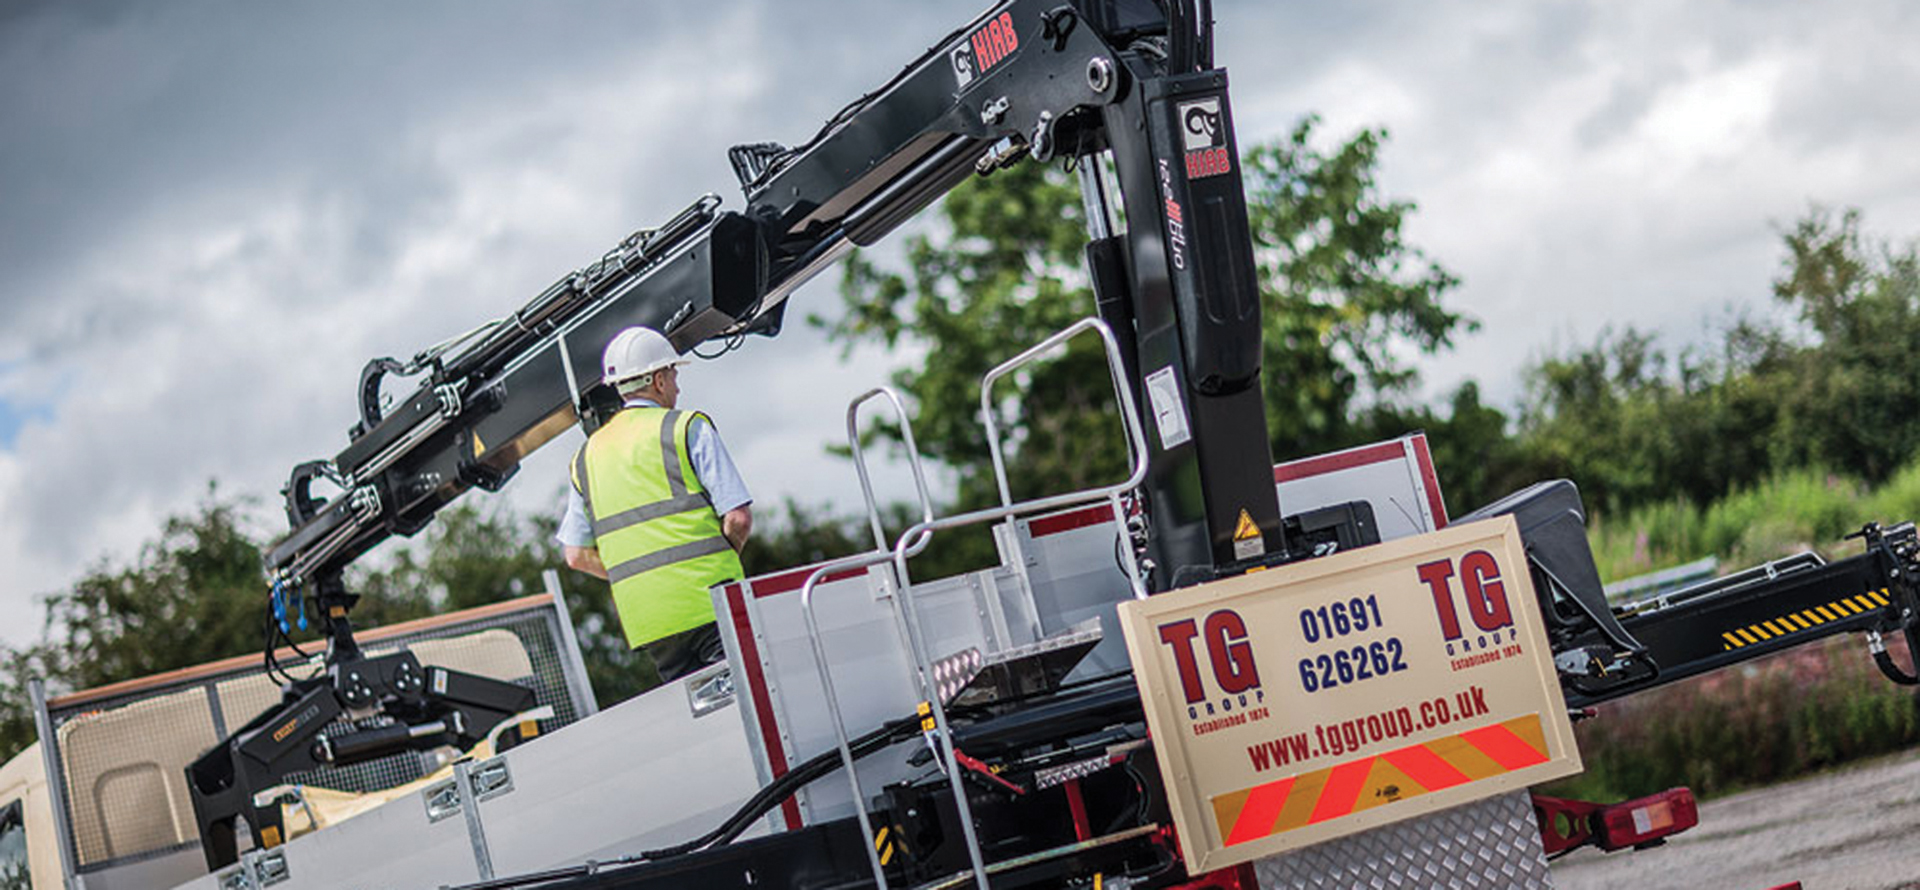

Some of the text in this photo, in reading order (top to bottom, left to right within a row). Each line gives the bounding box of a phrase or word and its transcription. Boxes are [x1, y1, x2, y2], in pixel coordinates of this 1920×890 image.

[971, 12, 1019, 73] HIAB
[1185, 148, 1230, 179] HIAB
[1299, 594, 1383, 644] 01691
[1416, 549, 1515, 642] TG
[1157, 608, 1262, 705] TG
[1298, 637, 1408, 693] 626262
[1445, 627, 1517, 657] GROUP
[1450, 649, 1501, 672] Established
[1186, 690, 1265, 720] GROUP
[1192, 712, 1247, 736] Established
[1247, 685, 1489, 773] www.tggroup.co.uk
